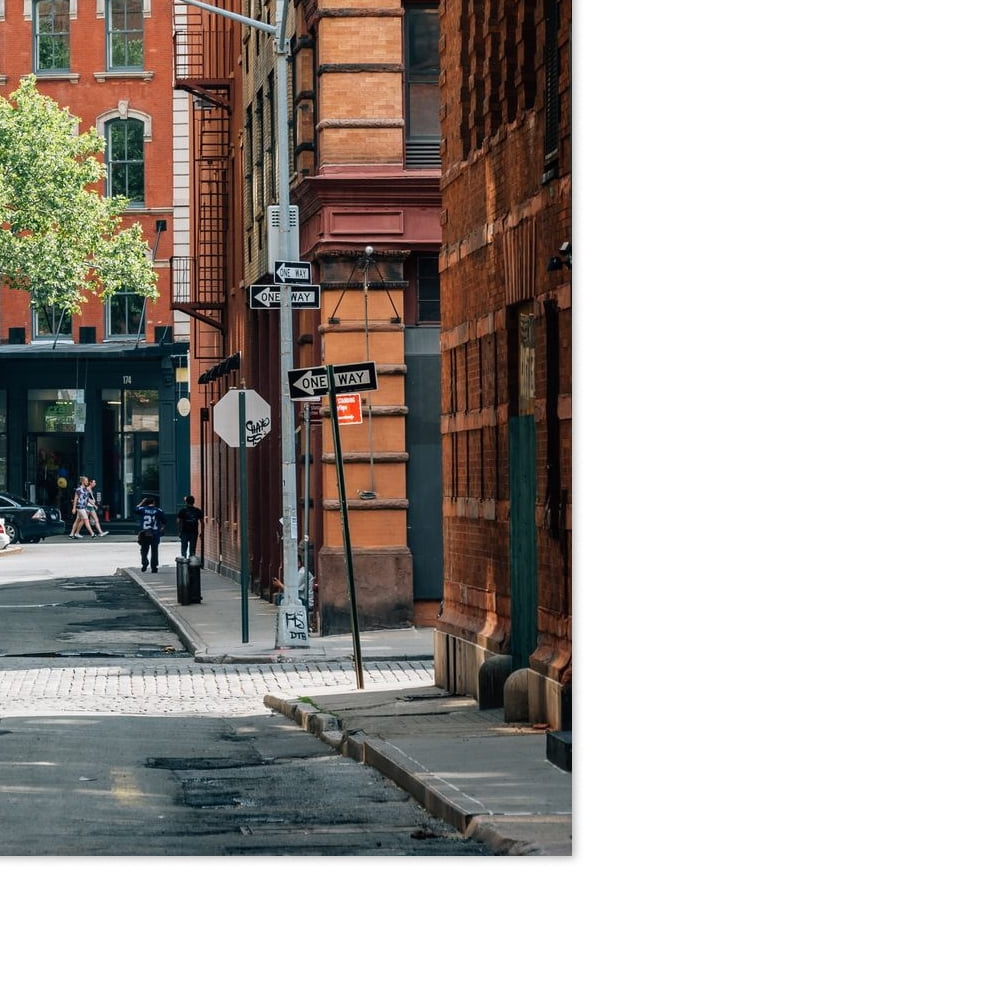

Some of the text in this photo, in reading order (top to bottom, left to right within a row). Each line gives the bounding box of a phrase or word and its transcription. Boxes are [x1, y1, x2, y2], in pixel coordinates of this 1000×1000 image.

[280, 268, 307, 279] ONE WAY
[261, 292, 311, 302] ONE WAY
[122, 375, 132, 385] 174
[302, 371, 364, 389] ONE WAY
[143, 515, 158, 530] 21
